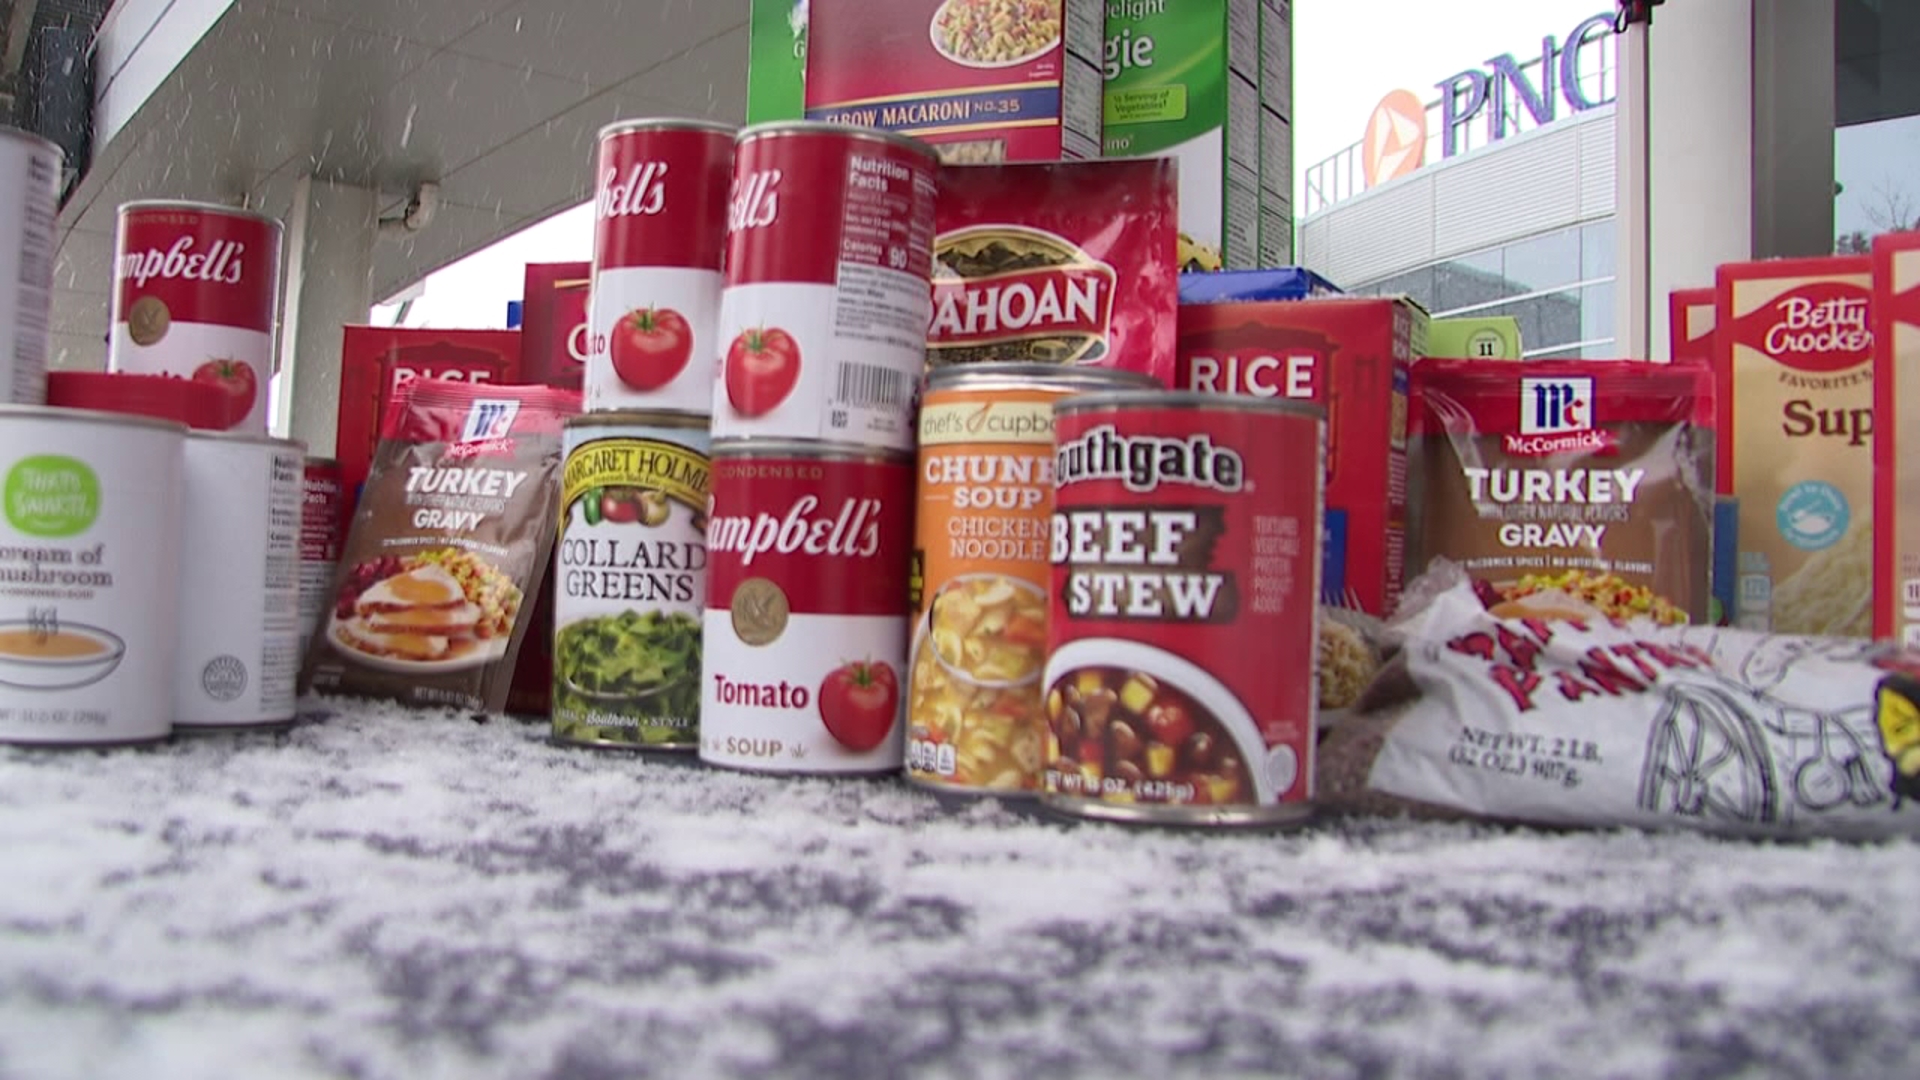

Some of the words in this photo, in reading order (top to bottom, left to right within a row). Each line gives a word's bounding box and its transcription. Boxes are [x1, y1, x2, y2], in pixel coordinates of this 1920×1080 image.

[1434, 12, 1615, 158] PNC
[882, 100, 970, 126] MACARONI
[850, 171, 889, 193] Facts
[851, 155, 909, 181] Nutrition
[119, 235, 244, 288] mpbell's
[926, 277, 1099, 336] AHOAN
[1776, 297, 1868, 331] Betty
[1190, 356, 1314, 397] RICE
[1783, 399, 1873, 446] Sup
[1506, 430, 1604, 453] McCormick
[406, 467, 527, 498] TURKEY
[1464, 468, 1644, 504] TURKEY
[954, 486, 1043, 509] SOUP
[414, 508, 485, 531] GRAVY
[949, 516, 1049, 541] CHICKEN
[951, 539, 1044, 560] NOODLE
[1051, 512, 1196, 564] BEEF
[1499, 524, 1605, 547] GRAVY
[80, 542, 105, 565] of
[563, 539, 706, 571] COLLARD
[566, 571, 693, 601] GREENS
[1070, 573, 1223, 617] STEW
[714, 674, 809, 709] Tomato
[586, 709, 639, 727] Southern
[726, 736, 783, 757] SOUP
[1553, 737, 1565, 755] 2
